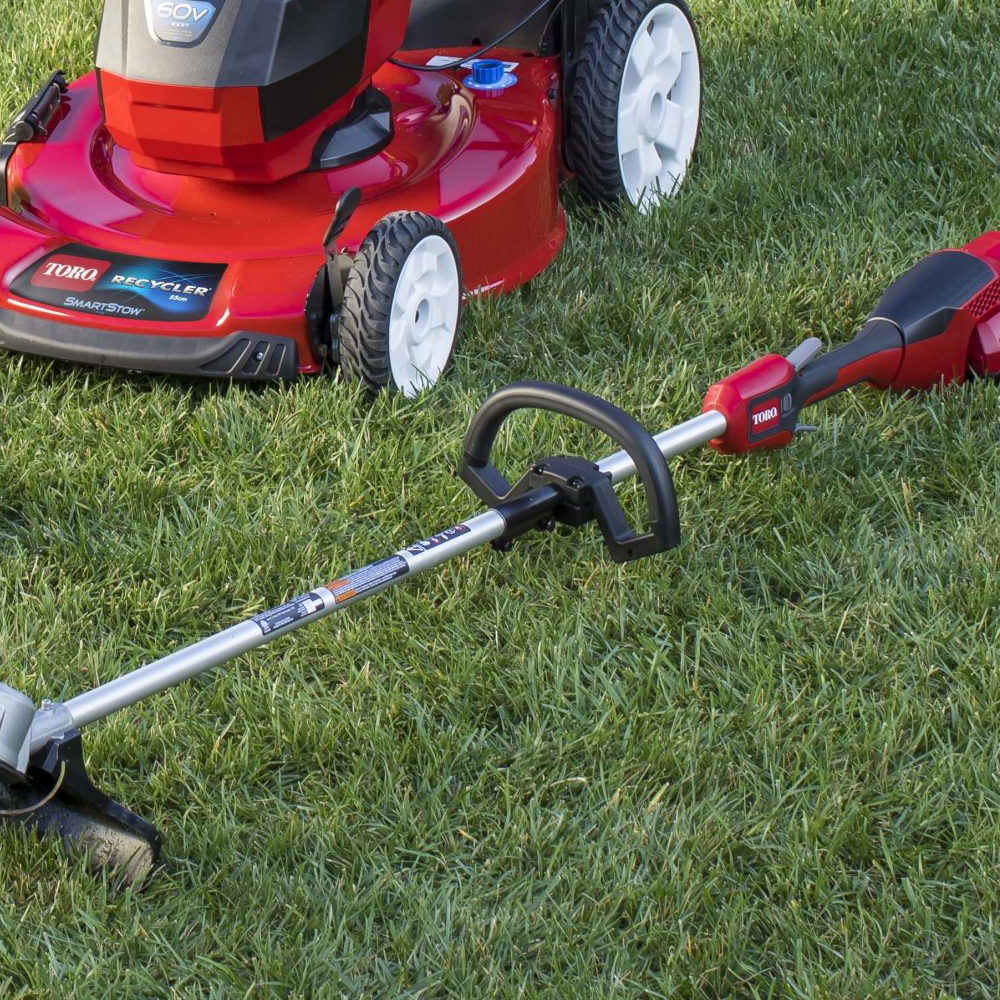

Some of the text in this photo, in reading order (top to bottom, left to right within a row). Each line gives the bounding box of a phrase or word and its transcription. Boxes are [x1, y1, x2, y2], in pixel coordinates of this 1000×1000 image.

[43, 262, 98, 281] TORO
[110, 274, 209, 297] RECYCLER
[63, 296, 143, 316] SMARTSTOW
[752, 406, 777, 425] TORO
